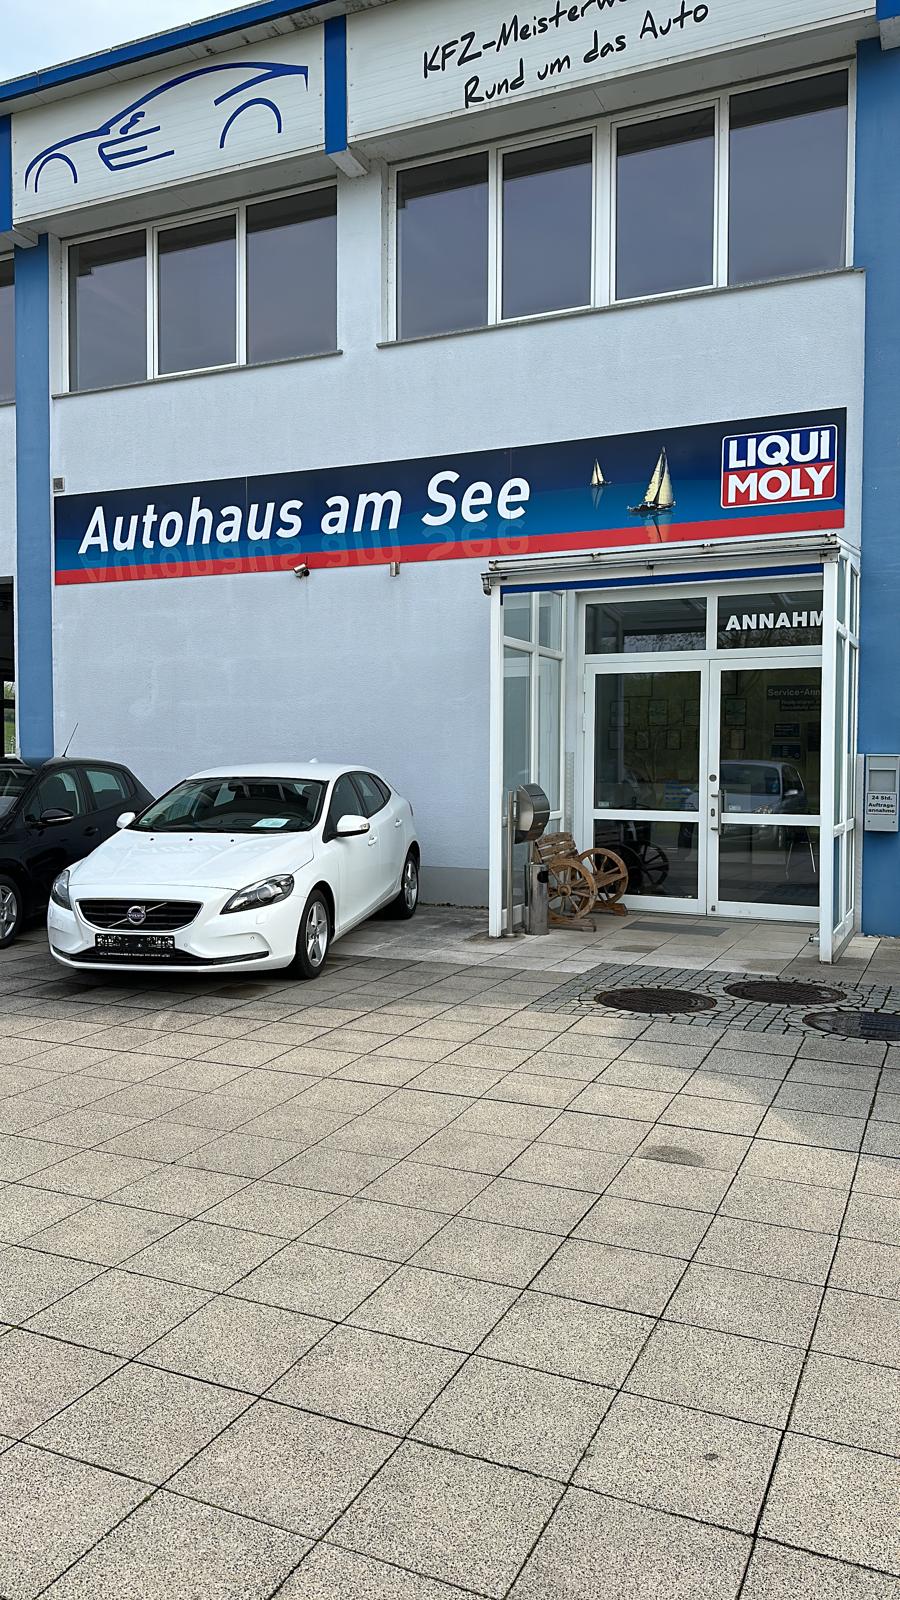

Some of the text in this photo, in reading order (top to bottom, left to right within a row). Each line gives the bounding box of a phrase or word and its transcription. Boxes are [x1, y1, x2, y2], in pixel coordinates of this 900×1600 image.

[423, 0, 627, 79] KFZ-Meisterw
[464, 0, 709, 109] Rund um das Auto
[727, 464, 834, 504] MOLY
[728, 429, 831, 469] LIQUI
[77, 469, 532, 555] Autohaus am See
